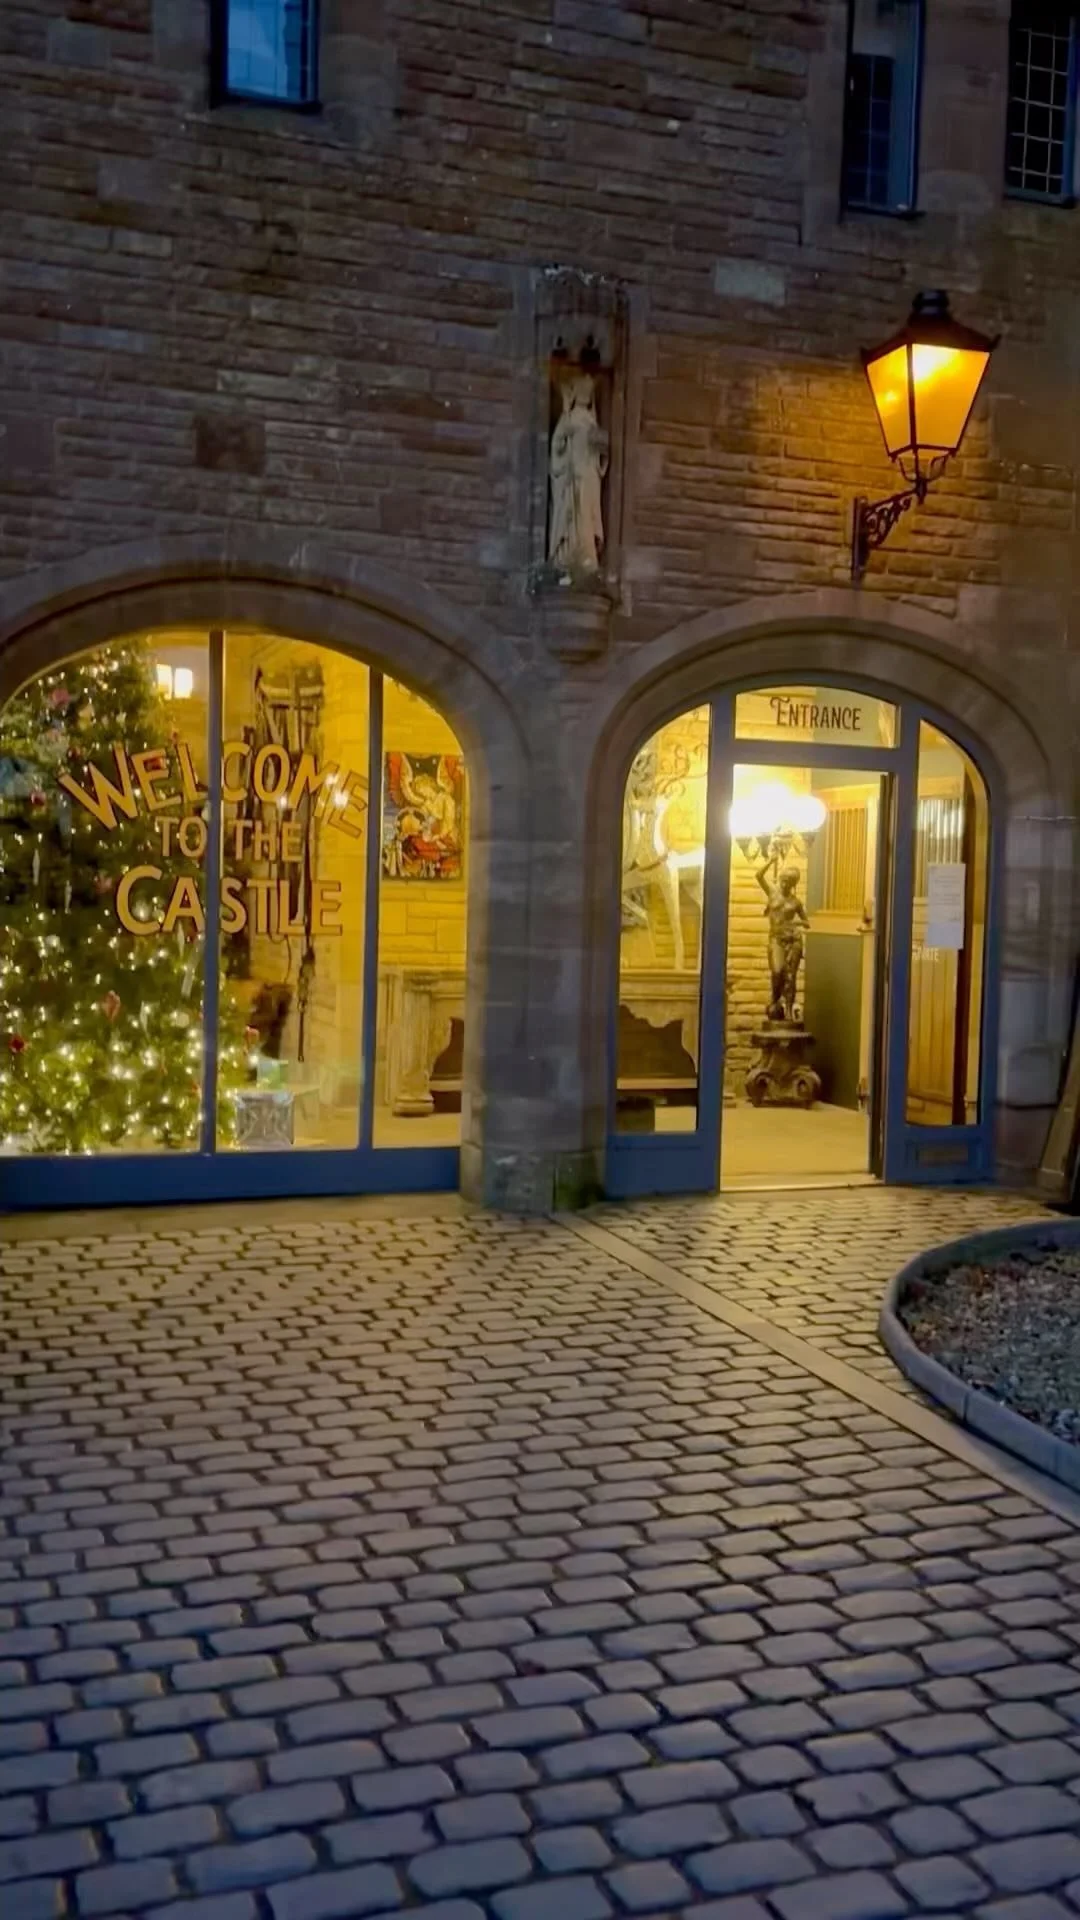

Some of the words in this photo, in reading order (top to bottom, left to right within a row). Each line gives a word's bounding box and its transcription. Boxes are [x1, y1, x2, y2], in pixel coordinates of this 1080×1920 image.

[770, 696, 862, 731] ENTRANCE
[58, 741, 369, 839] WELCOME
[155, 815, 208, 858] TO
[231, 819, 303, 862] THE
[116, 865, 343, 936] CASTLE
